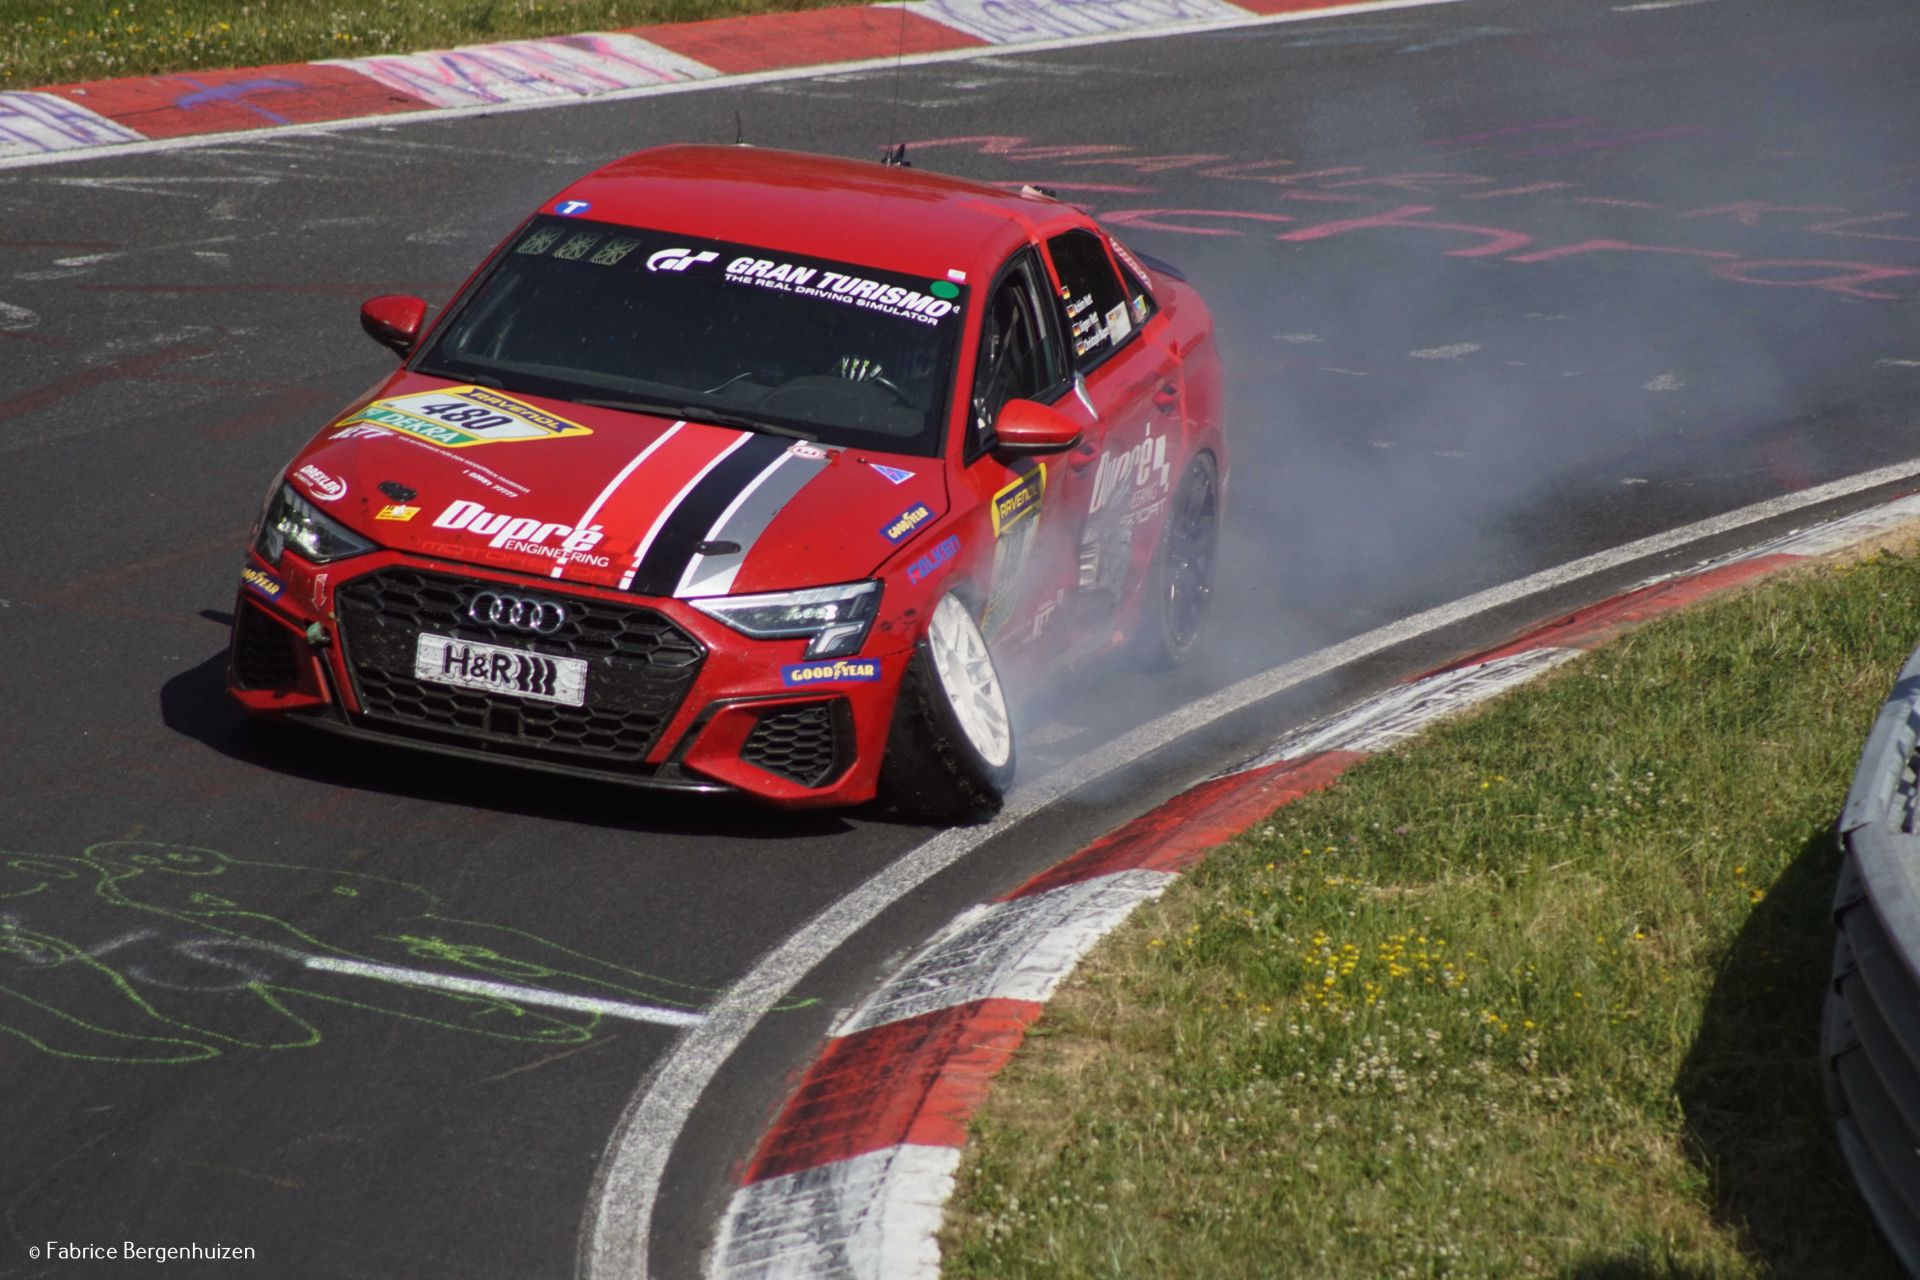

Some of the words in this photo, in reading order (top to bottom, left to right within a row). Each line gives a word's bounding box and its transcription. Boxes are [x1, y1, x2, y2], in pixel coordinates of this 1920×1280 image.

[562, 200, 588, 214] T
[725, 256, 819, 285] GRAN
[813, 271, 952, 318] TURISMO
[725, 273, 754, 284] THE
[755, 277, 792, 292] REAL
[795, 284, 853, 304] DRIVING
[855, 298, 939, 327] SIMULATOR
[378, 412, 459, 443] DEKRA
[421, 402, 513, 430] 480
[469, 391, 560, 429] RAVENOL
[299, 464, 342, 494] DREXLER
[1000, 484, 1038, 519] RAVENOL
[432, 499, 604, 552] Dupré
[505, 539, 610, 568] ENGINEERING
[907, 534, 962, 585] FALKEN
[443, 644, 512, 685] H&R
[791, 661, 874, 681] GOODYEAR
